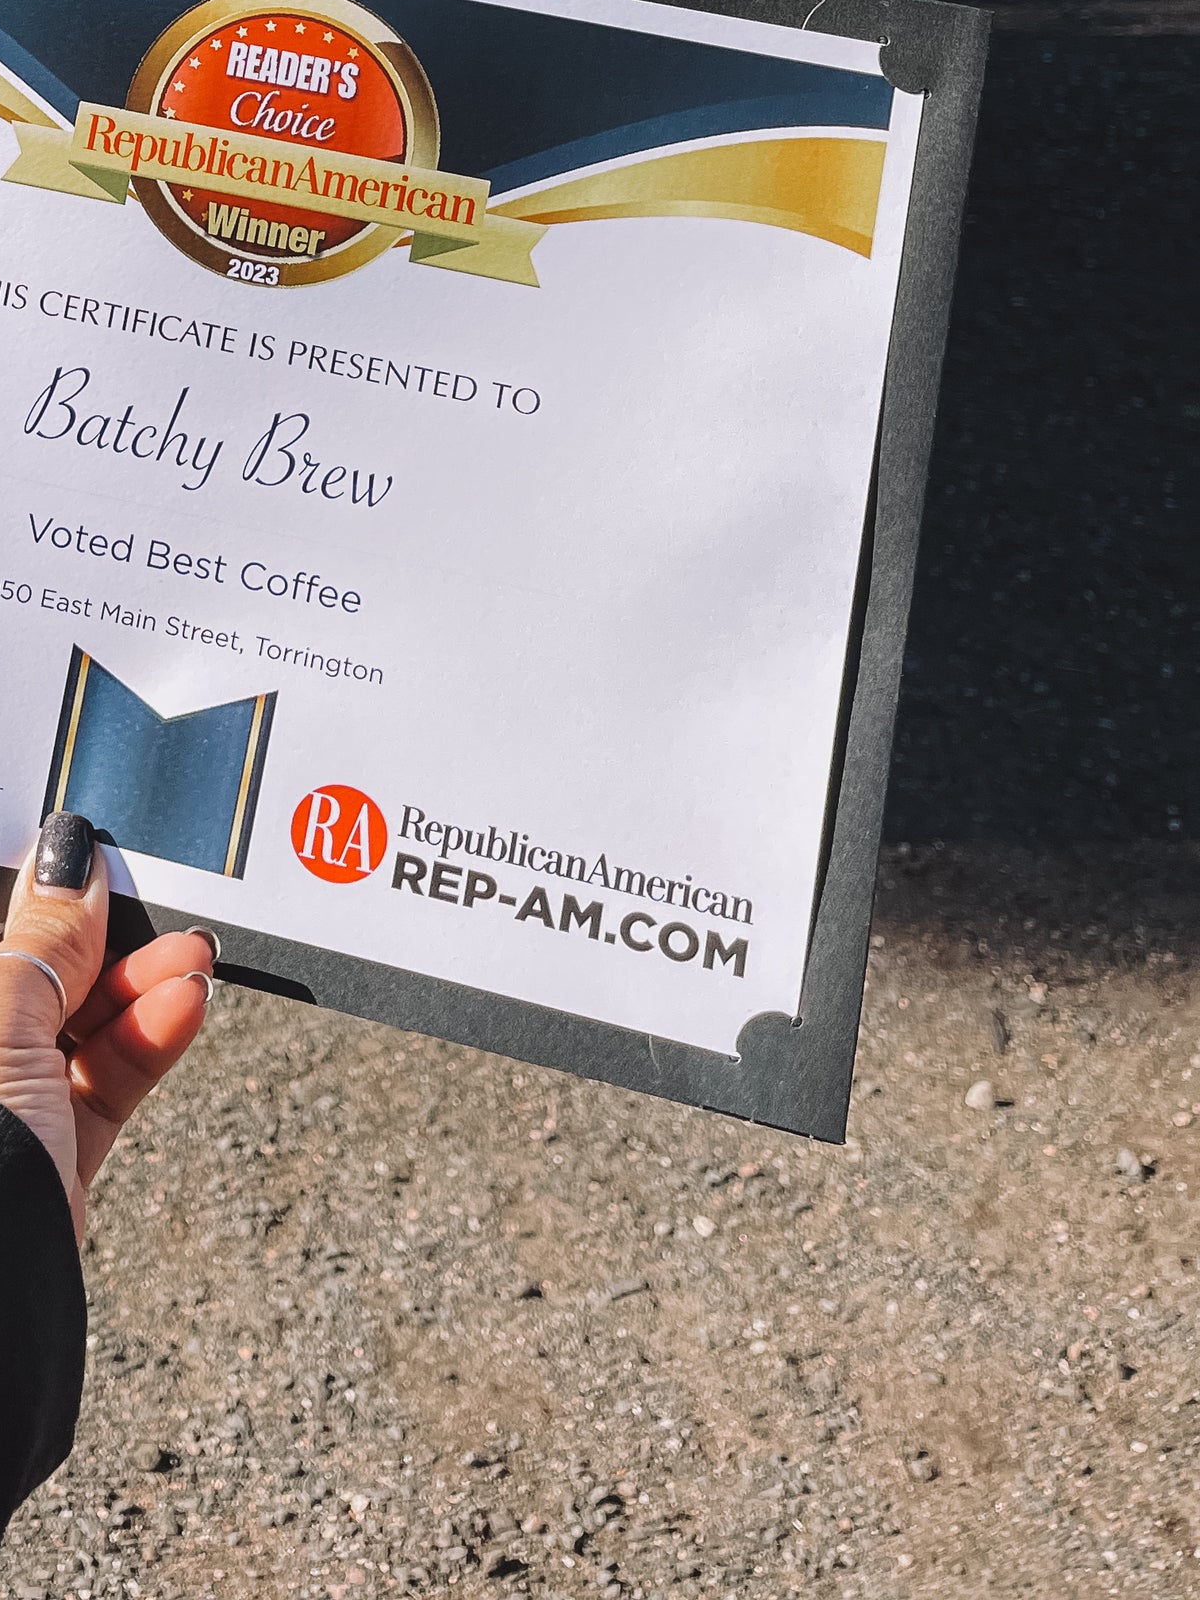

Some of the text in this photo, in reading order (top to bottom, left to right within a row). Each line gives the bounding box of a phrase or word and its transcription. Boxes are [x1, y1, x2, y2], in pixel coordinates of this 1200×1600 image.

[225, 40, 361, 101] READER’S
[228, 90, 337, 143] Choice
[83, 113, 477, 226] RepublicanAmerican
[205, 201, 326, 257] Winner
[226, 257, 281, 287] 2023
[38, 289, 238, 354] CERTIFICATE
[248, 332, 276, 362] IS
[288, 340, 479, 404] PRESENTED
[492, 380, 542, 416] TO
[23, 365, 394, 509] Batchy Brew
[28, 511, 363, 615] Voted Best Coffee
[40, 587, 93, 620] East
[99, 602, 157, 633] Main
[166, 616, 245, 656] Street,
[254, 634, 385, 686] Torrington
[297, 790, 375, 874] RA
[397, 804, 756, 926] RepublicanAmerican
[390, 850, 750, 979] REP-AM.COM
